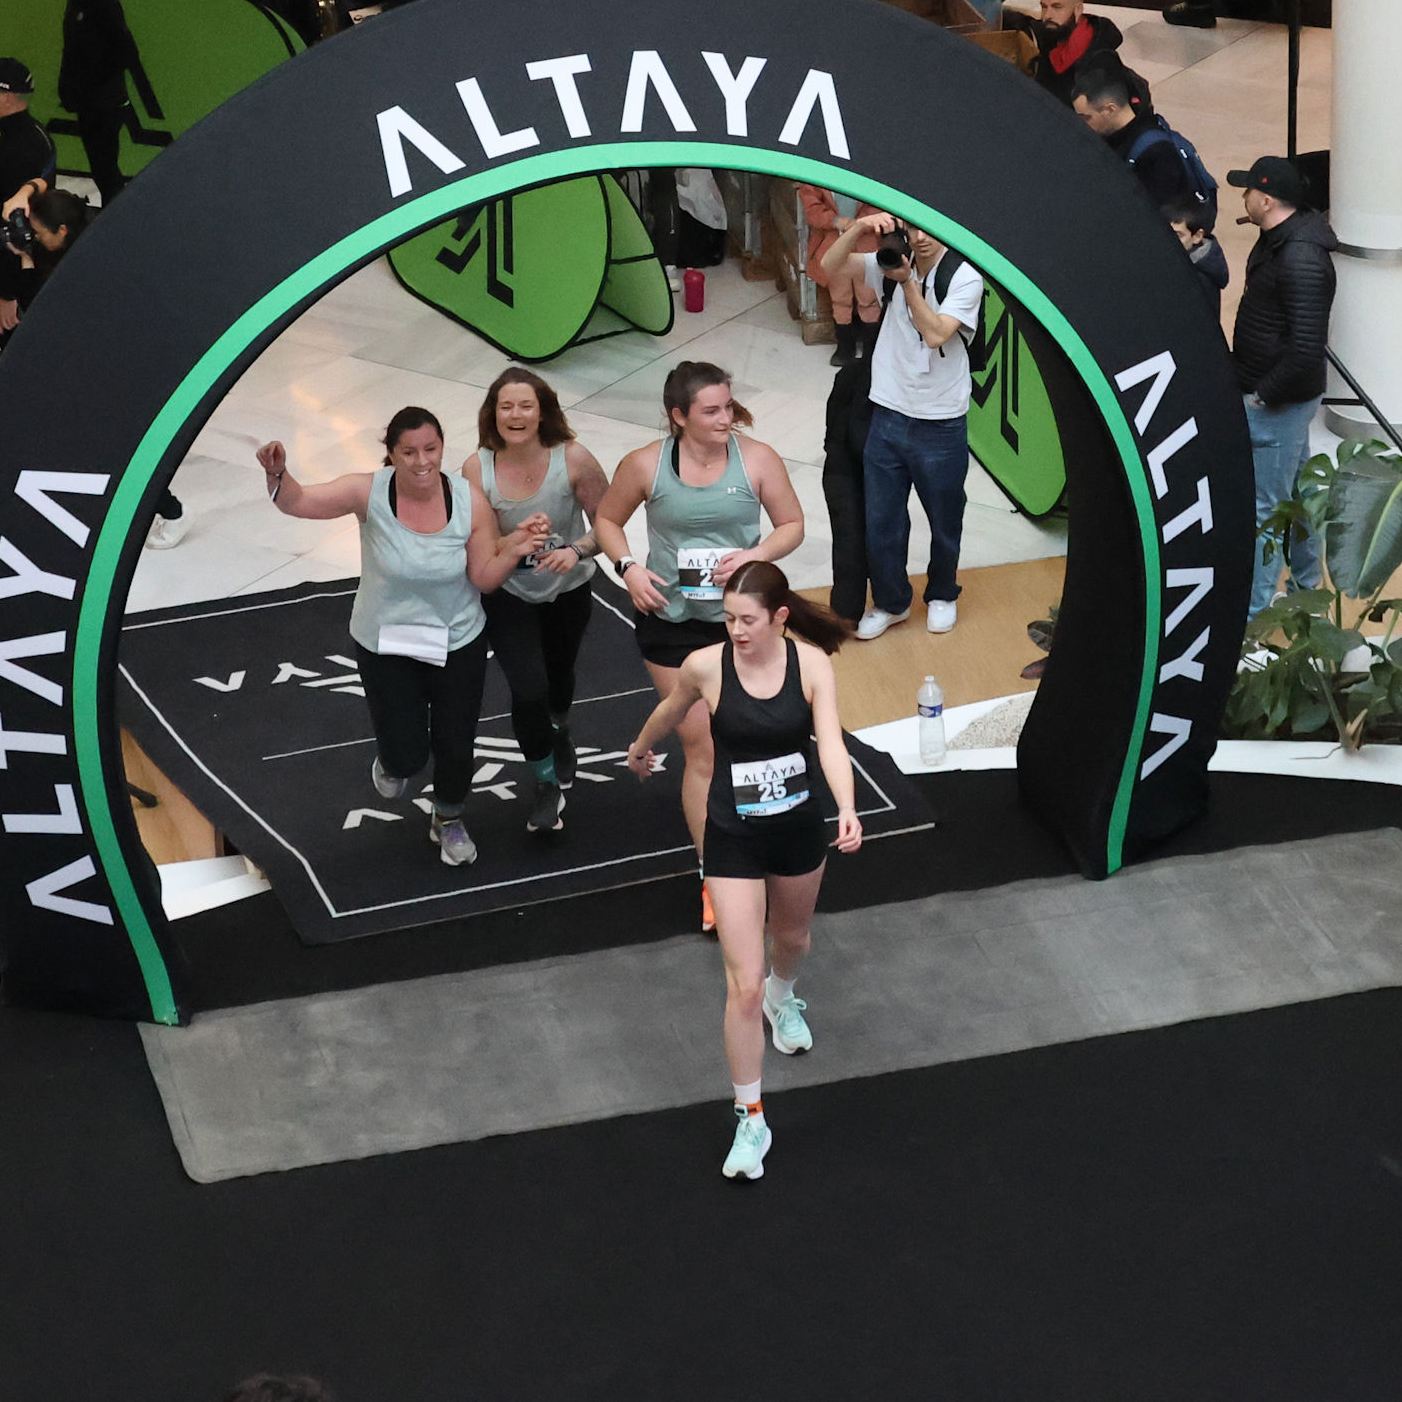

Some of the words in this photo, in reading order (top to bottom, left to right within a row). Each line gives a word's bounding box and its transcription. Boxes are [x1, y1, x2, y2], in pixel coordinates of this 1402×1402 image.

[376, 50, 851, 199] ALTAYA
[687, 557, 720, 568] ALTA
[1114, 350, 1214, 781] ALTAYA
[699, 569, 713, 587] 2
[744, 765, 797, 783] ALTAYA
[758, 779, 787, 803] 25
